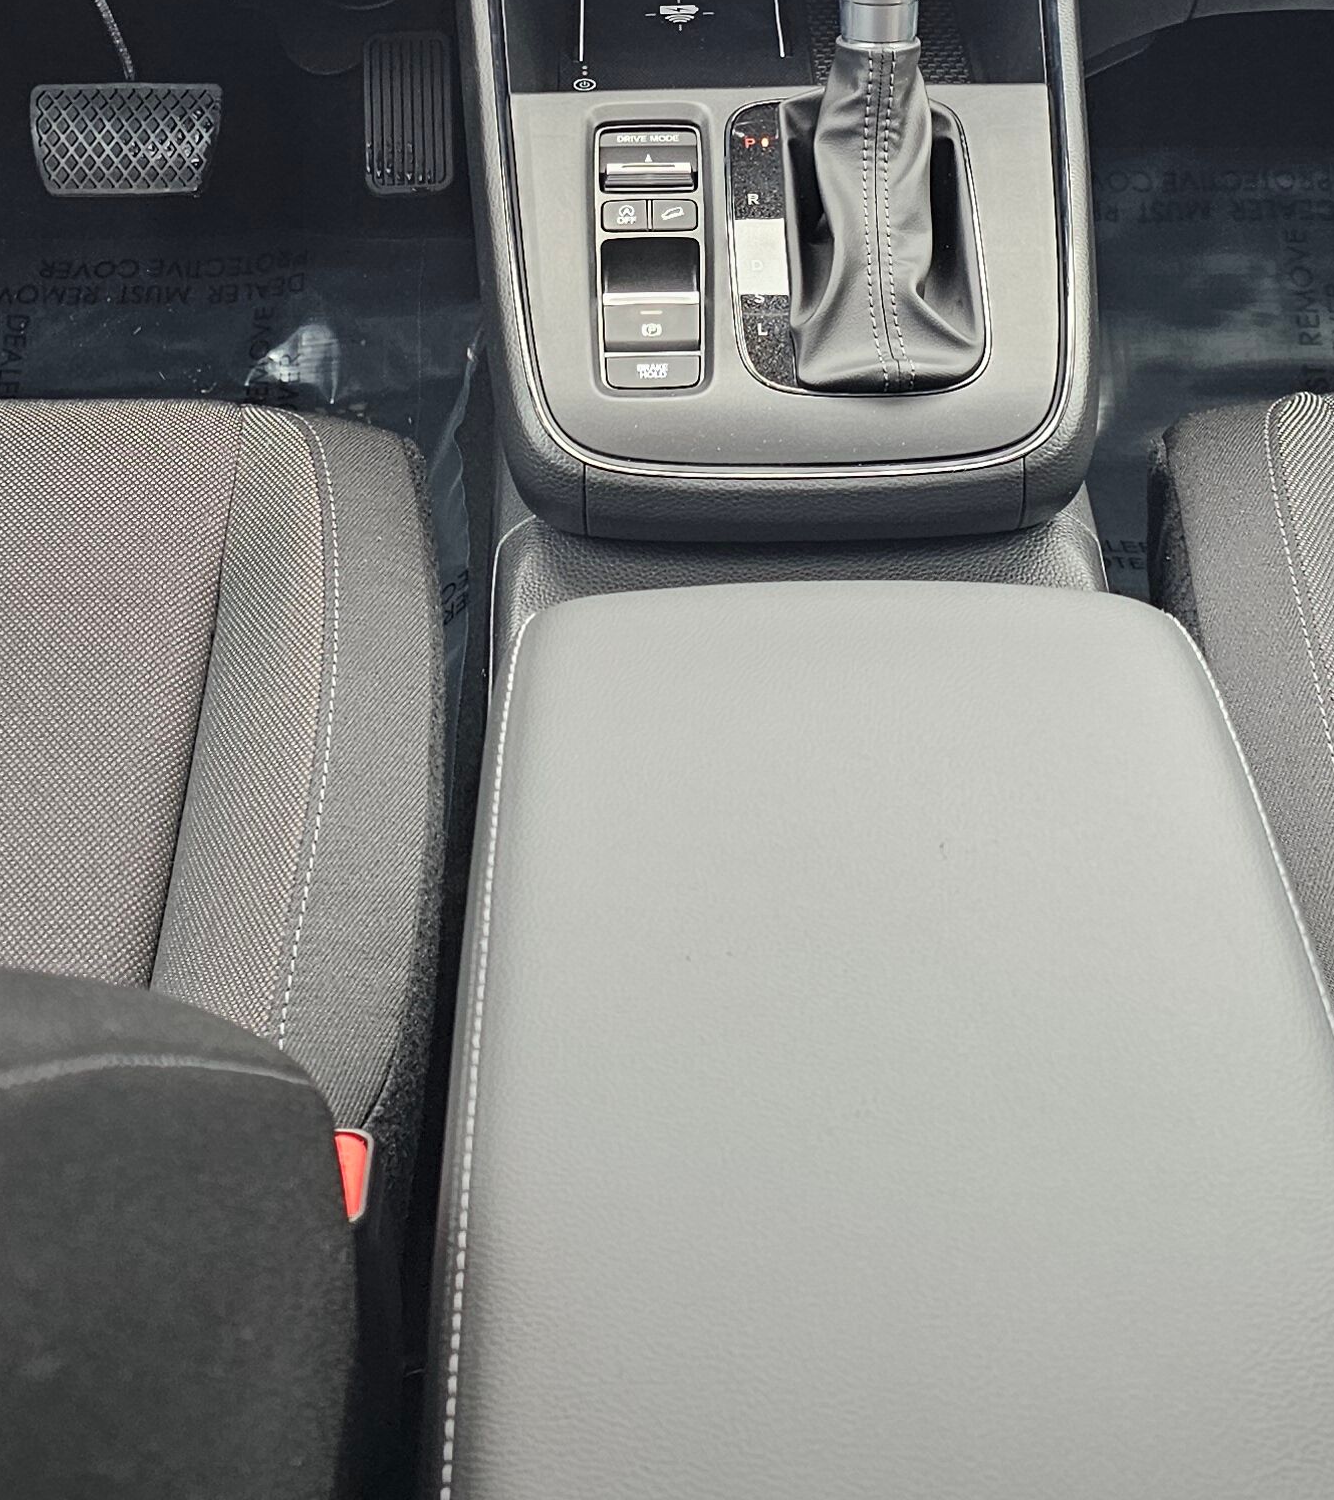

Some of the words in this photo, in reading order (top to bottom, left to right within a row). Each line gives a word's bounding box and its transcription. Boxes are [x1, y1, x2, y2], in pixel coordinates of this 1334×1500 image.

[617, 135, 647, 143] DRIVE
[650, 134, 680, 142] MODE
[744, 138, 756, 149] P
[747, 193, 759, 205] R
[617, 216, 637, 225] OFF
[38, 258, 141, 279] COVER
[116, 285, 192, 305] MUST
[757, 323, 768, 335] L
[636, 364, 668, 372] BRAKE
[639, 371, 668, 379] HOLD
